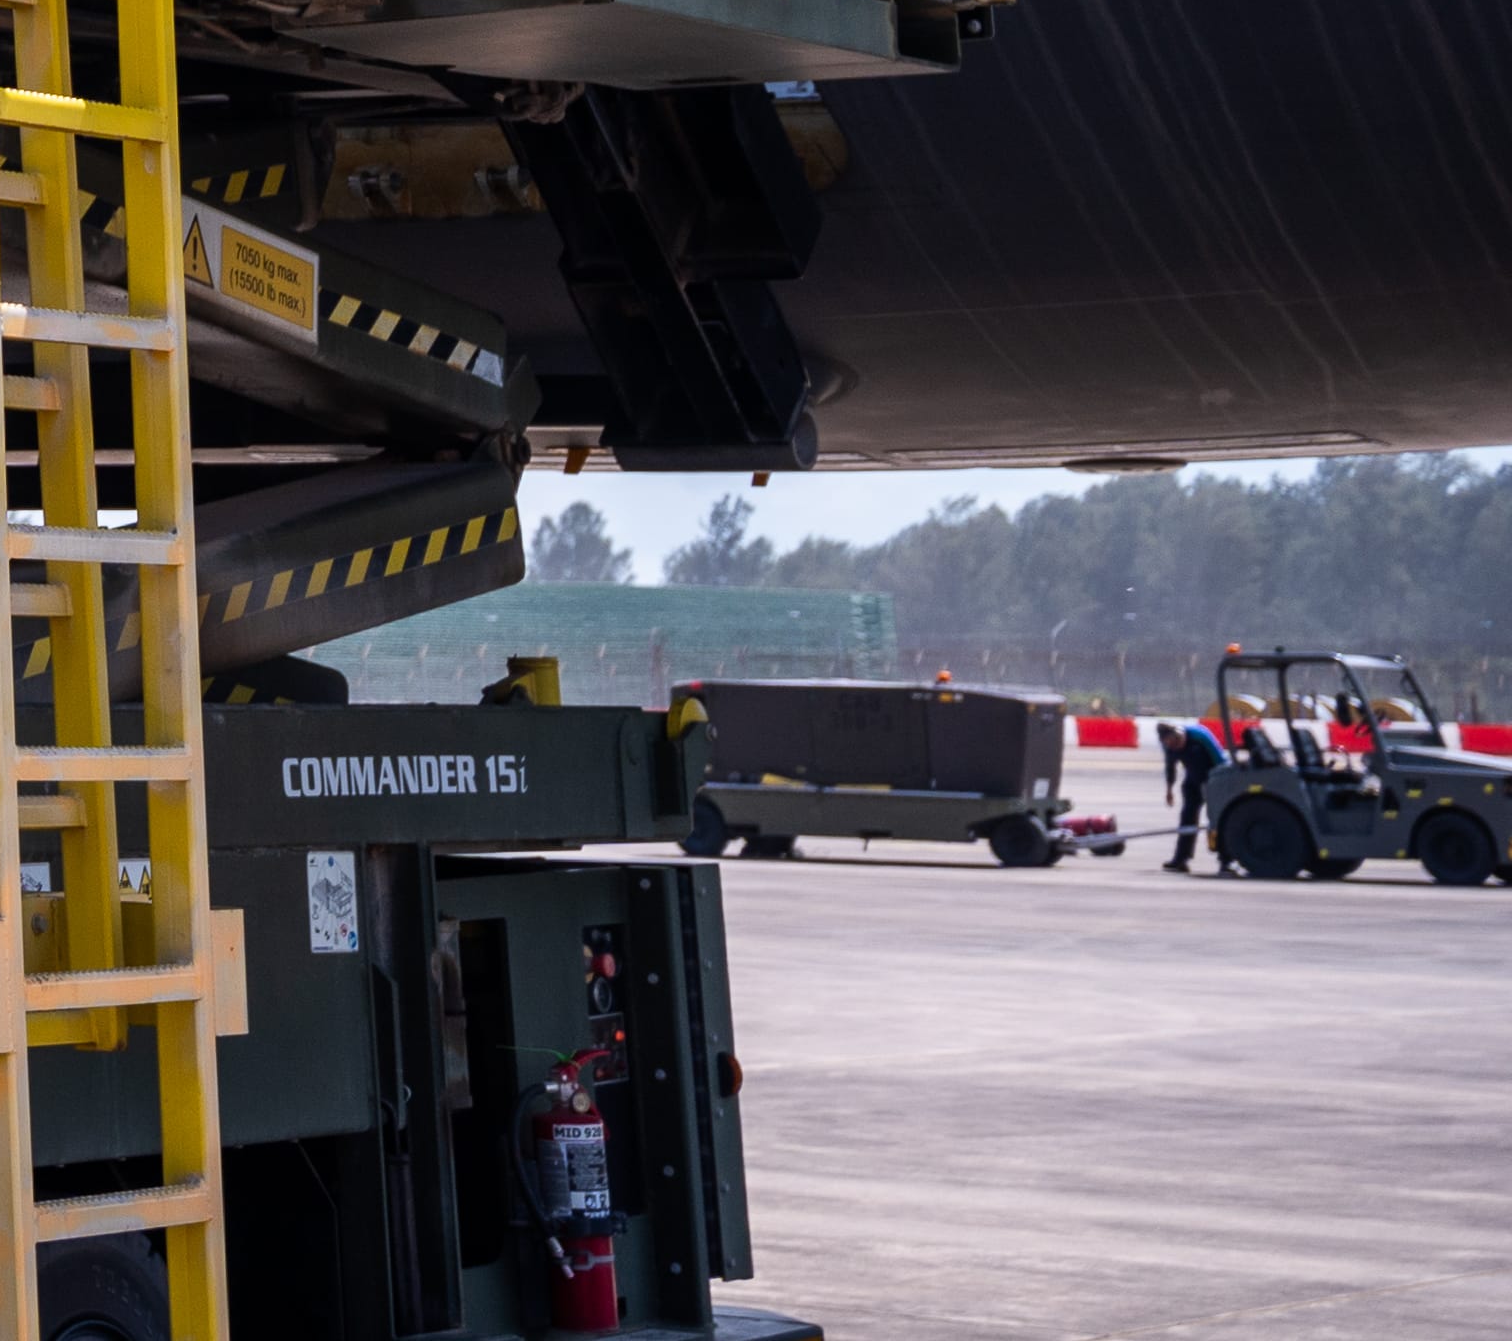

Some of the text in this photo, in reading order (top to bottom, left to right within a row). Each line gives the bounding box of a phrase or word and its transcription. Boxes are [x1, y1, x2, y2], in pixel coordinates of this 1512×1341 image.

[235, 242, 302, 286] 7050 kg max.
[229, 267, 306, 319] (15500 lb max.)
[282, 755, 528, 798] COMMANDER 15i
[554, 1127, 582, 1138] MID
